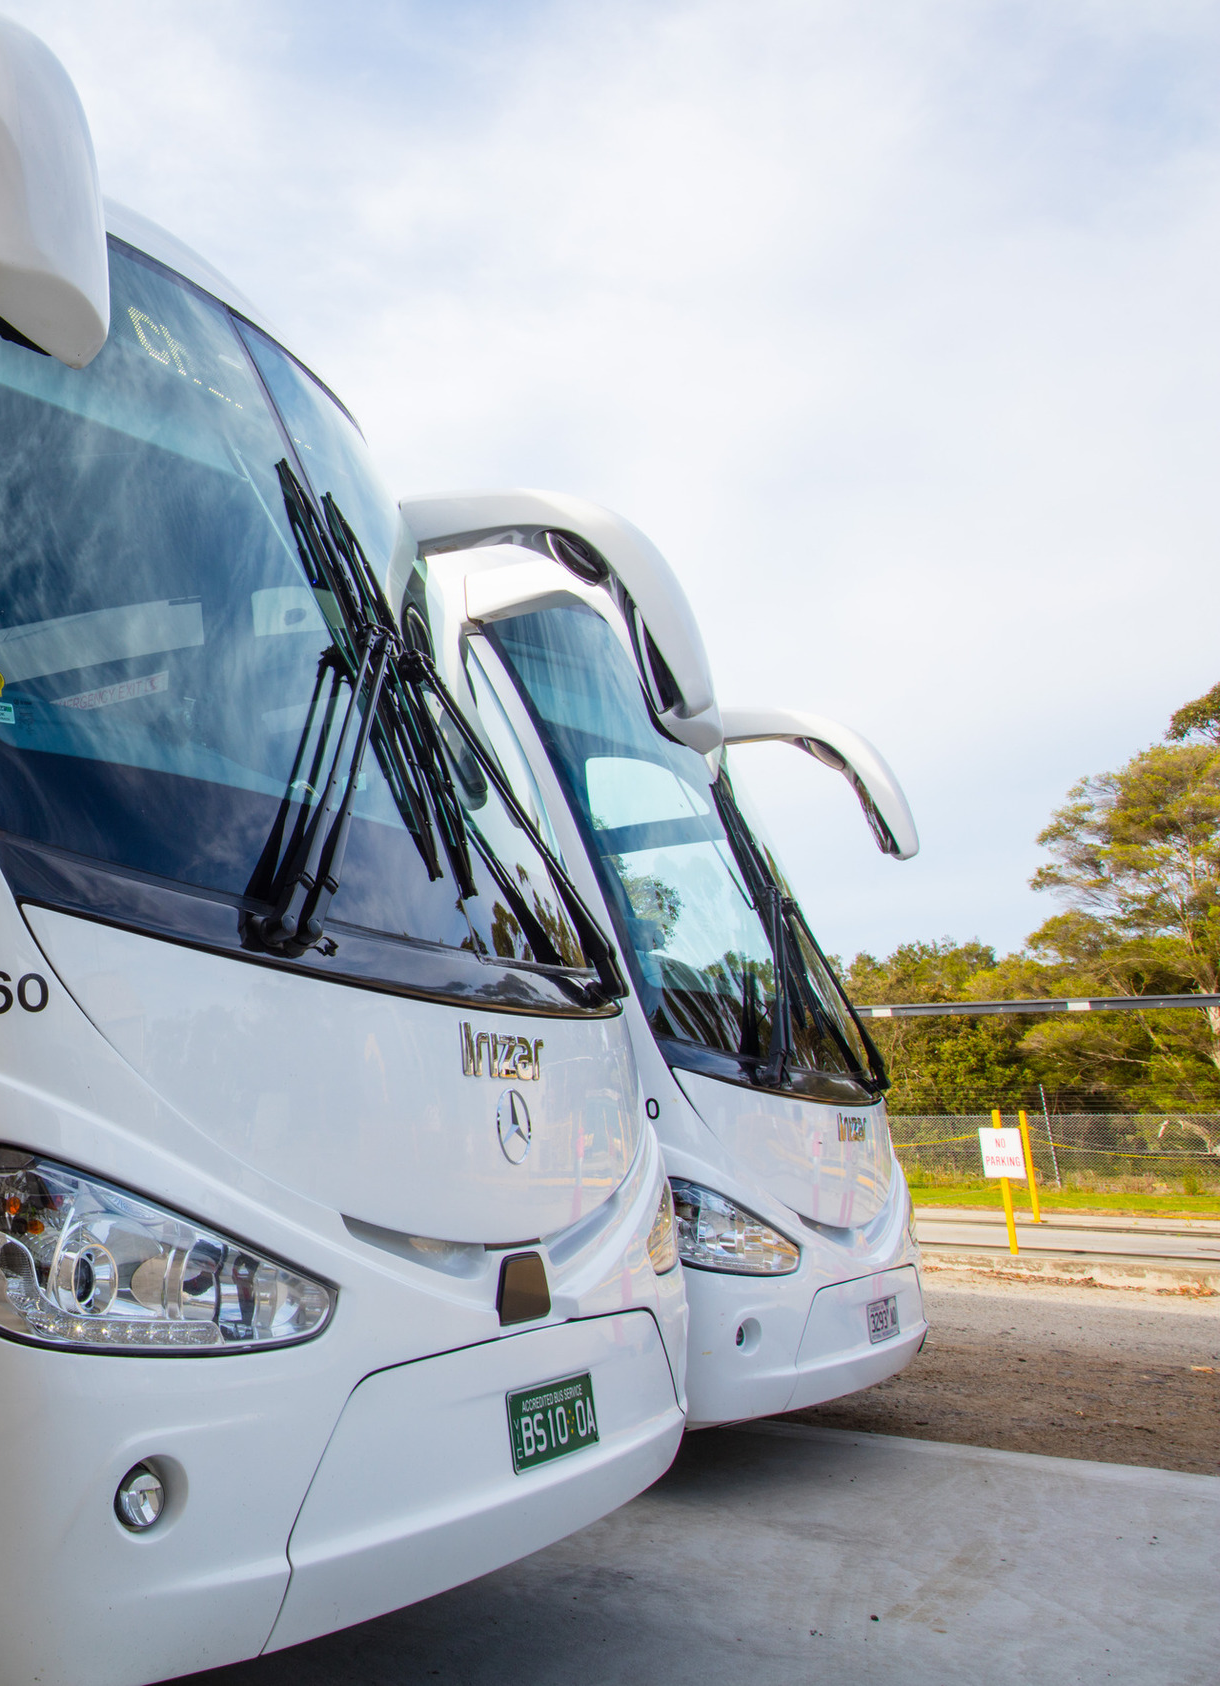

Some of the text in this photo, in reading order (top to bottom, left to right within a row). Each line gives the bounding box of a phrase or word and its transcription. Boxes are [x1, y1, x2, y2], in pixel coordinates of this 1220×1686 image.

[118, 680, 143, 700] EXIT
[459, 1021, 544, 1081] Irizar
[837, 1112, 866, 1142] Irizar
[995, 1137, 1006, 1149] NO
[985, 1155, 1021, 1167] PARKING
[522, 1384, 583, 1413] ACCREDITED BUS SERVICE
